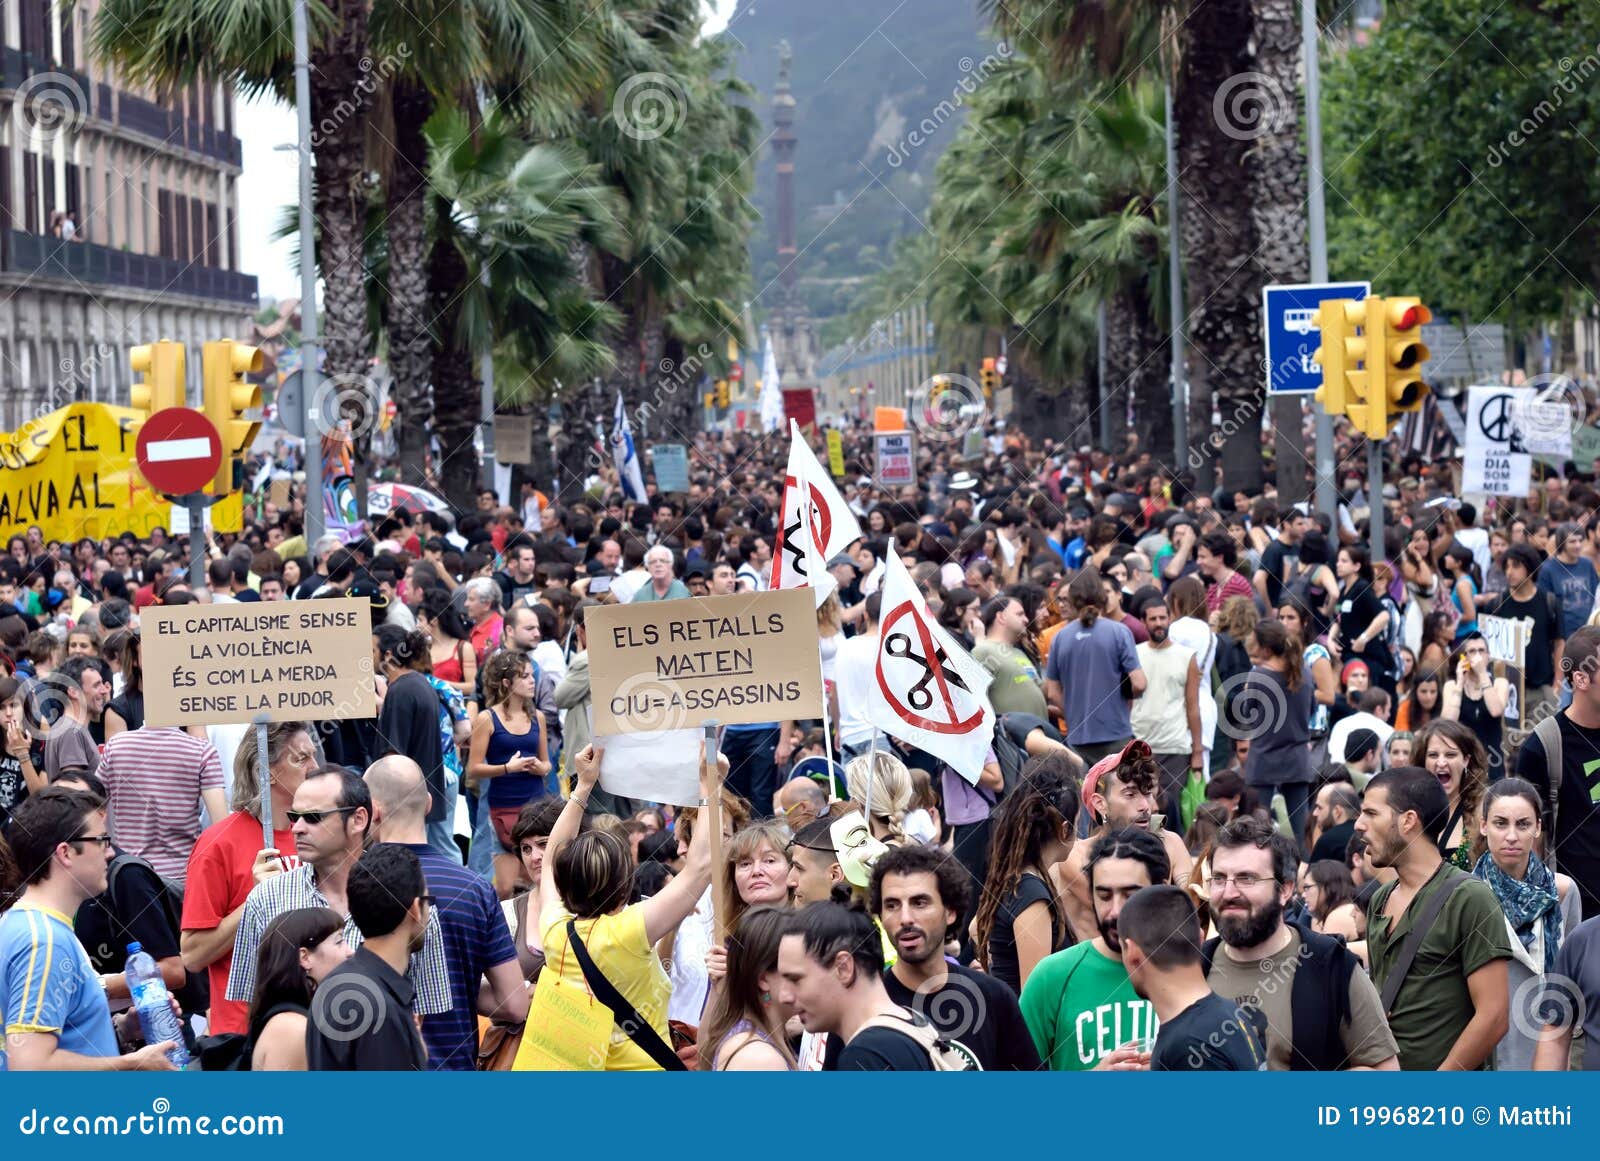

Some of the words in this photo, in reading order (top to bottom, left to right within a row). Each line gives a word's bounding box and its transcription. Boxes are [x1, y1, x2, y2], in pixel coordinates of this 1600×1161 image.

[1485, 458, 1511, 469] DIA
[1484, 471, 1510, 480] SOM
[68, 472, 115, 509] AL
[158, 620, 180, 634] EL
[185, 614, 290, 633] CAPITALISME
[300, 612, 357, 629] SENSE
[613, 624, 659, 648] ELS
[669, 613, 784, 642] RETALLS
[190, 644, 213, 659] LA
[217, 636, 312, 657] VIOLÈNCIA
[656, 648, 753, 677] MATEN
[172, 666, 196, 687] ÉS
[207, 669, 245, 685] COM
[251, 669, 273, 683] LA
[278, 665, 337, 681] MERDA
[179, 696, 237, 712] SENSE
[246, 694, 272, 709] LA
[278, 690, 335, 708] PUDOR
[1076, 1000, 1160, 1065] CELTI
